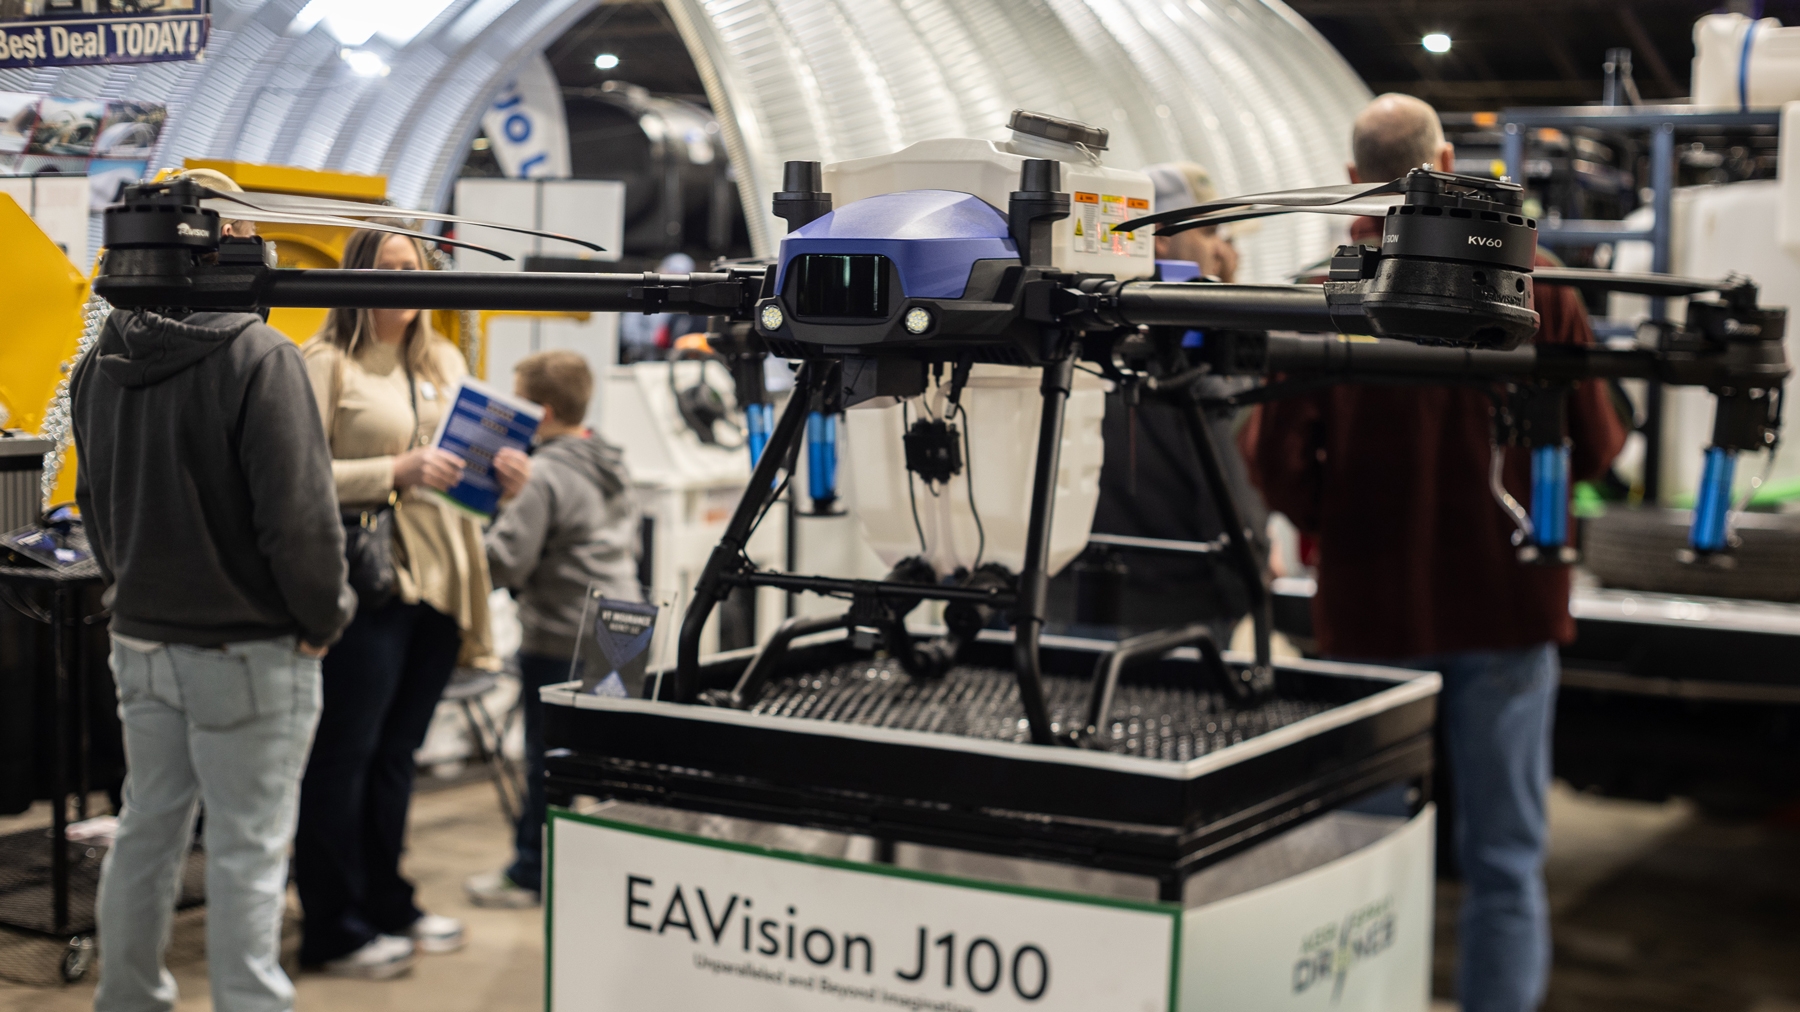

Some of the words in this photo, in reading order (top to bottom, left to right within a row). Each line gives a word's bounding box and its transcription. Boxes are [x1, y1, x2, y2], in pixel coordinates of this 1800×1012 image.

[50, 25, 106, 58] Deal
[111, 21, 199, 56] TODAY!
[1468, 235, 1502, 248] KV60
[626, 875, 873, 974] EAVision
[896, 926, 1049, 1001] J100
